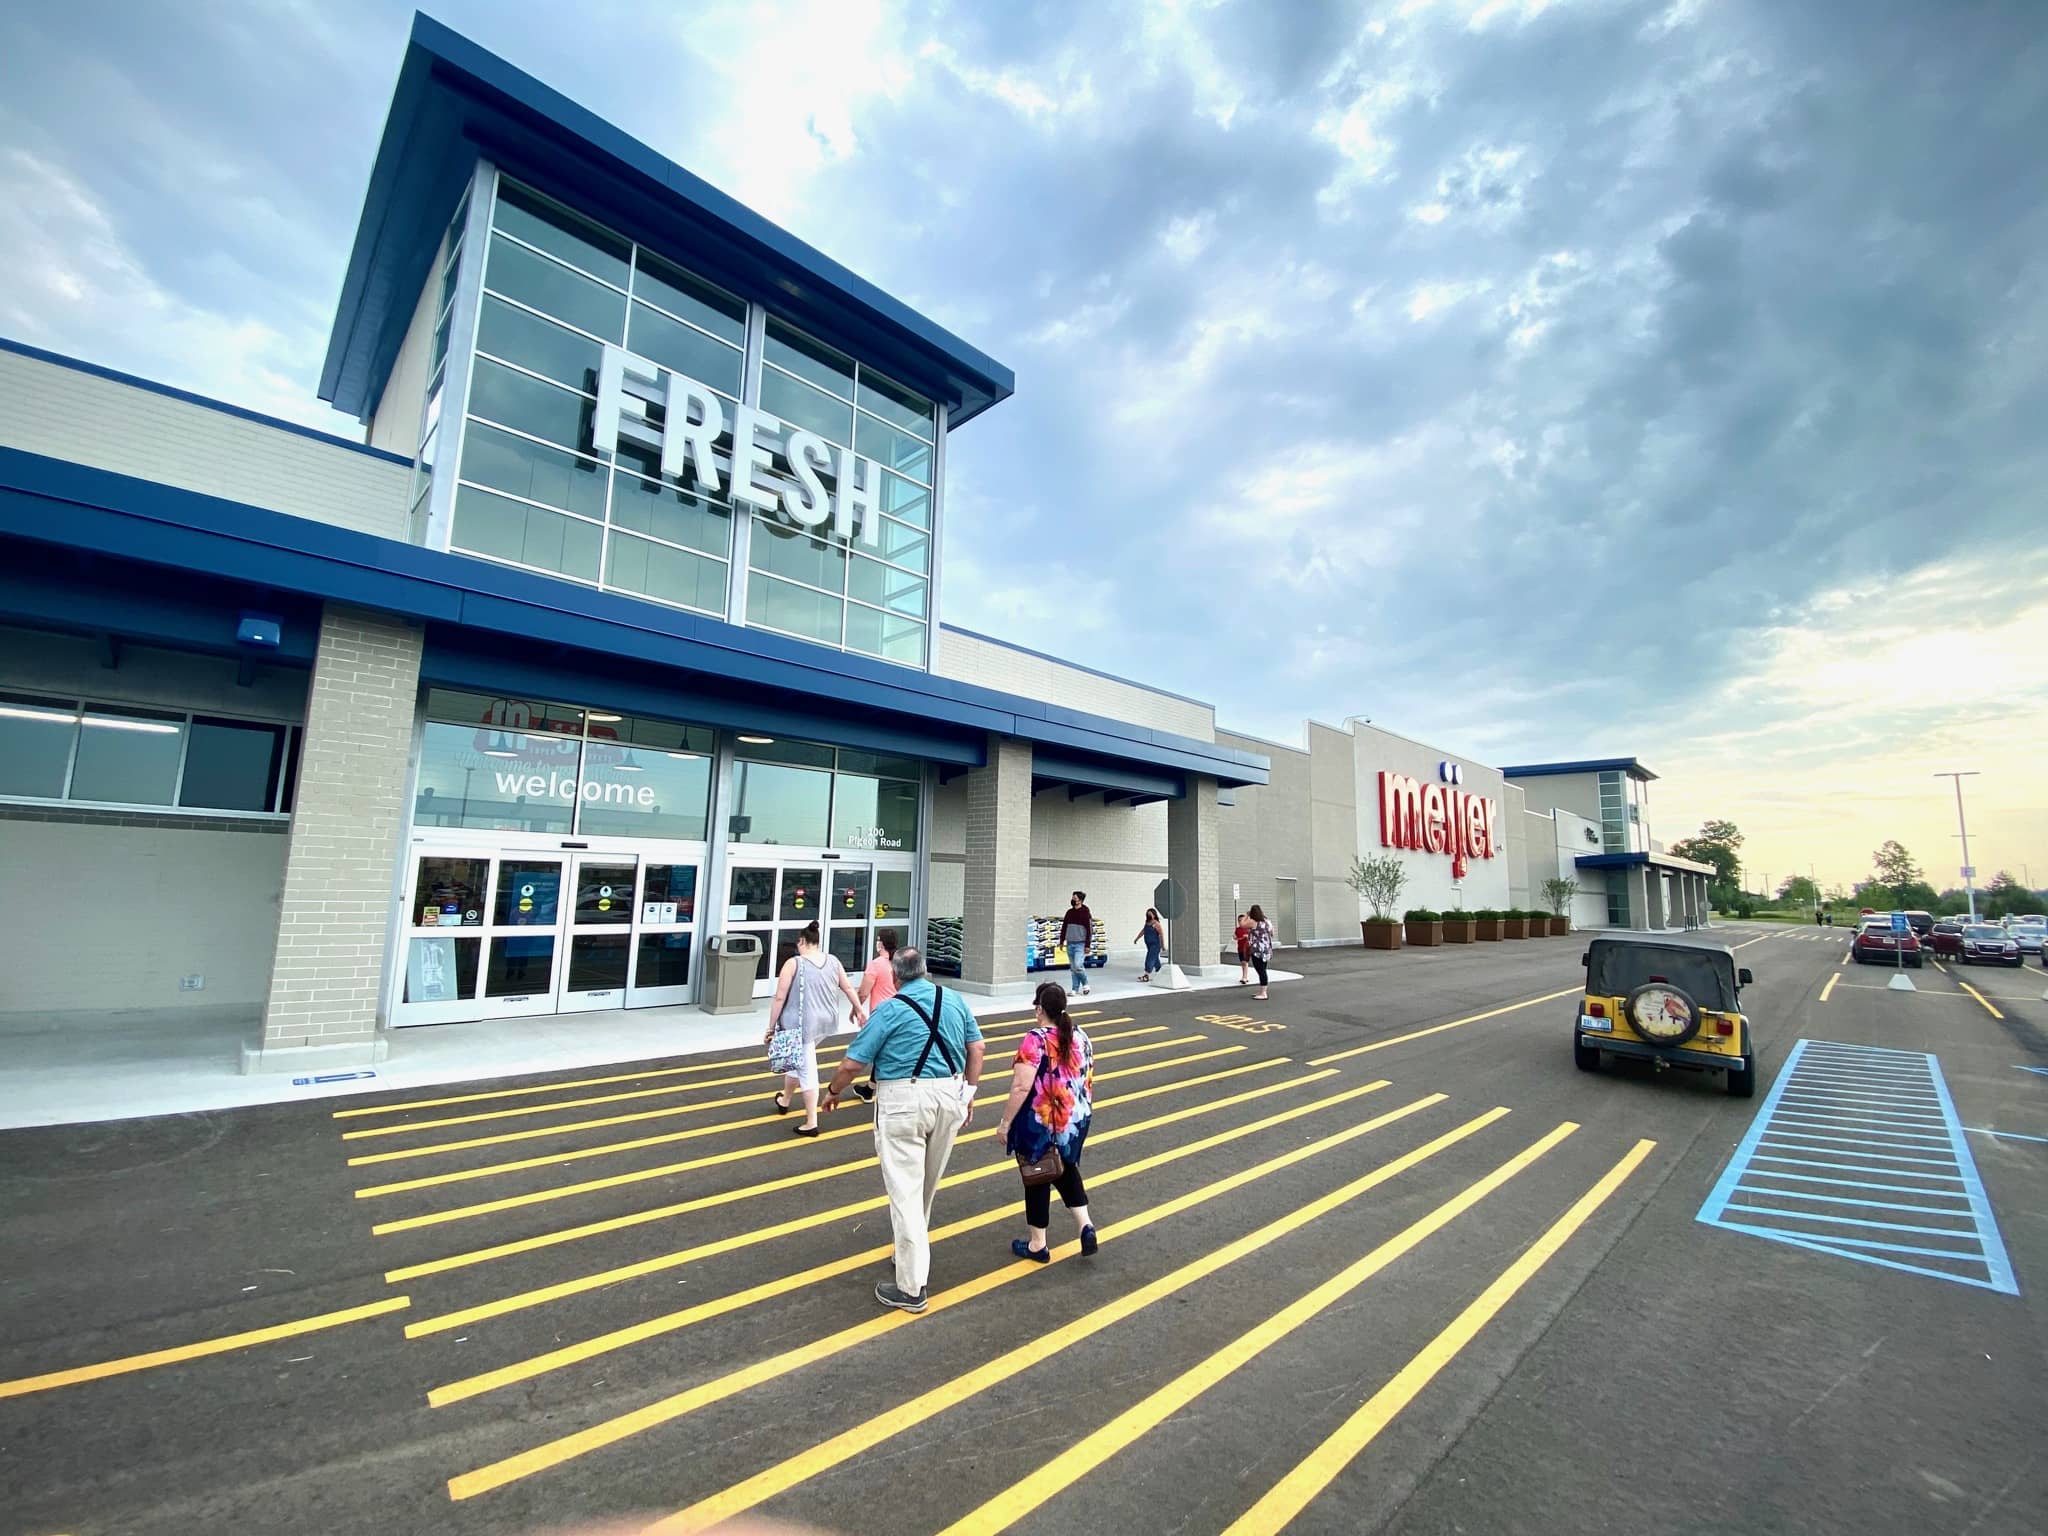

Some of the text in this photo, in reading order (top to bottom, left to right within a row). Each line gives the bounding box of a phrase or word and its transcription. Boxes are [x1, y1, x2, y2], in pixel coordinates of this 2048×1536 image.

[592, 344, 882, 547] FRESH
[495, 771, 656, 805] welcome
[1377, 761, 1497, 880] meijer
[880, 837, 902, 848] Road
[1194, 1014, 1288, 1034] STOP
